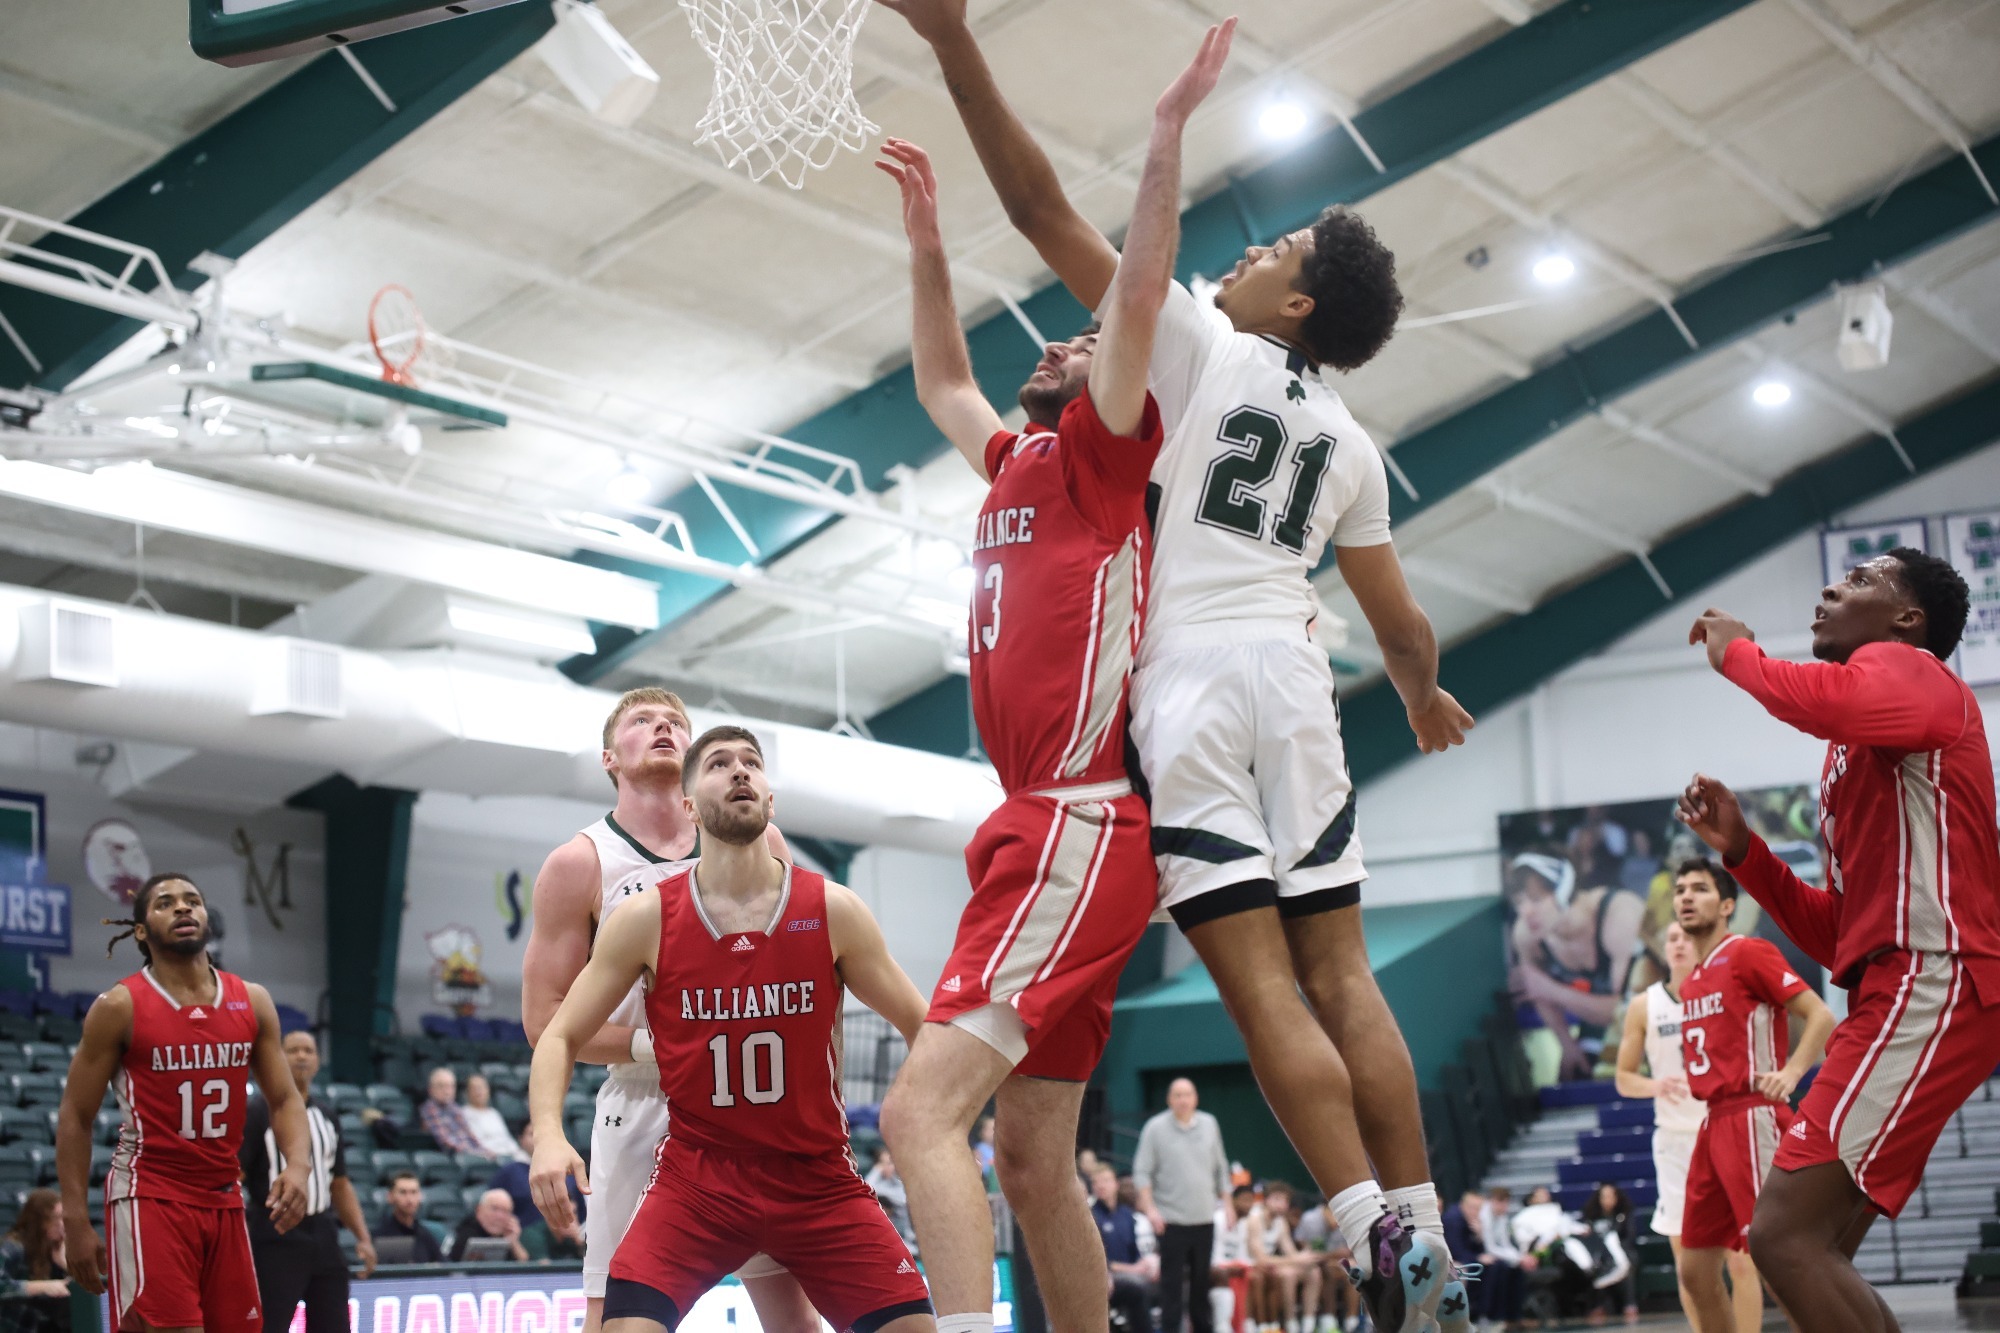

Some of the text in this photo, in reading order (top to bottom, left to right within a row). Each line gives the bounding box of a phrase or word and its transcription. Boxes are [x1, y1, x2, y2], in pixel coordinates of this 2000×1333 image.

[1195, 404, 1337, 556] 21
[731, 944, 756, 952] adidas
[681, 980, 815, 1020] ALLIANCE
[151, 1042, 253, 1071] ALLIANCE
[708, 1030, 786, 1108] 10
[1685, 1026, 1711, 1076] 3
[177, 1078, 230, 1140] 12
